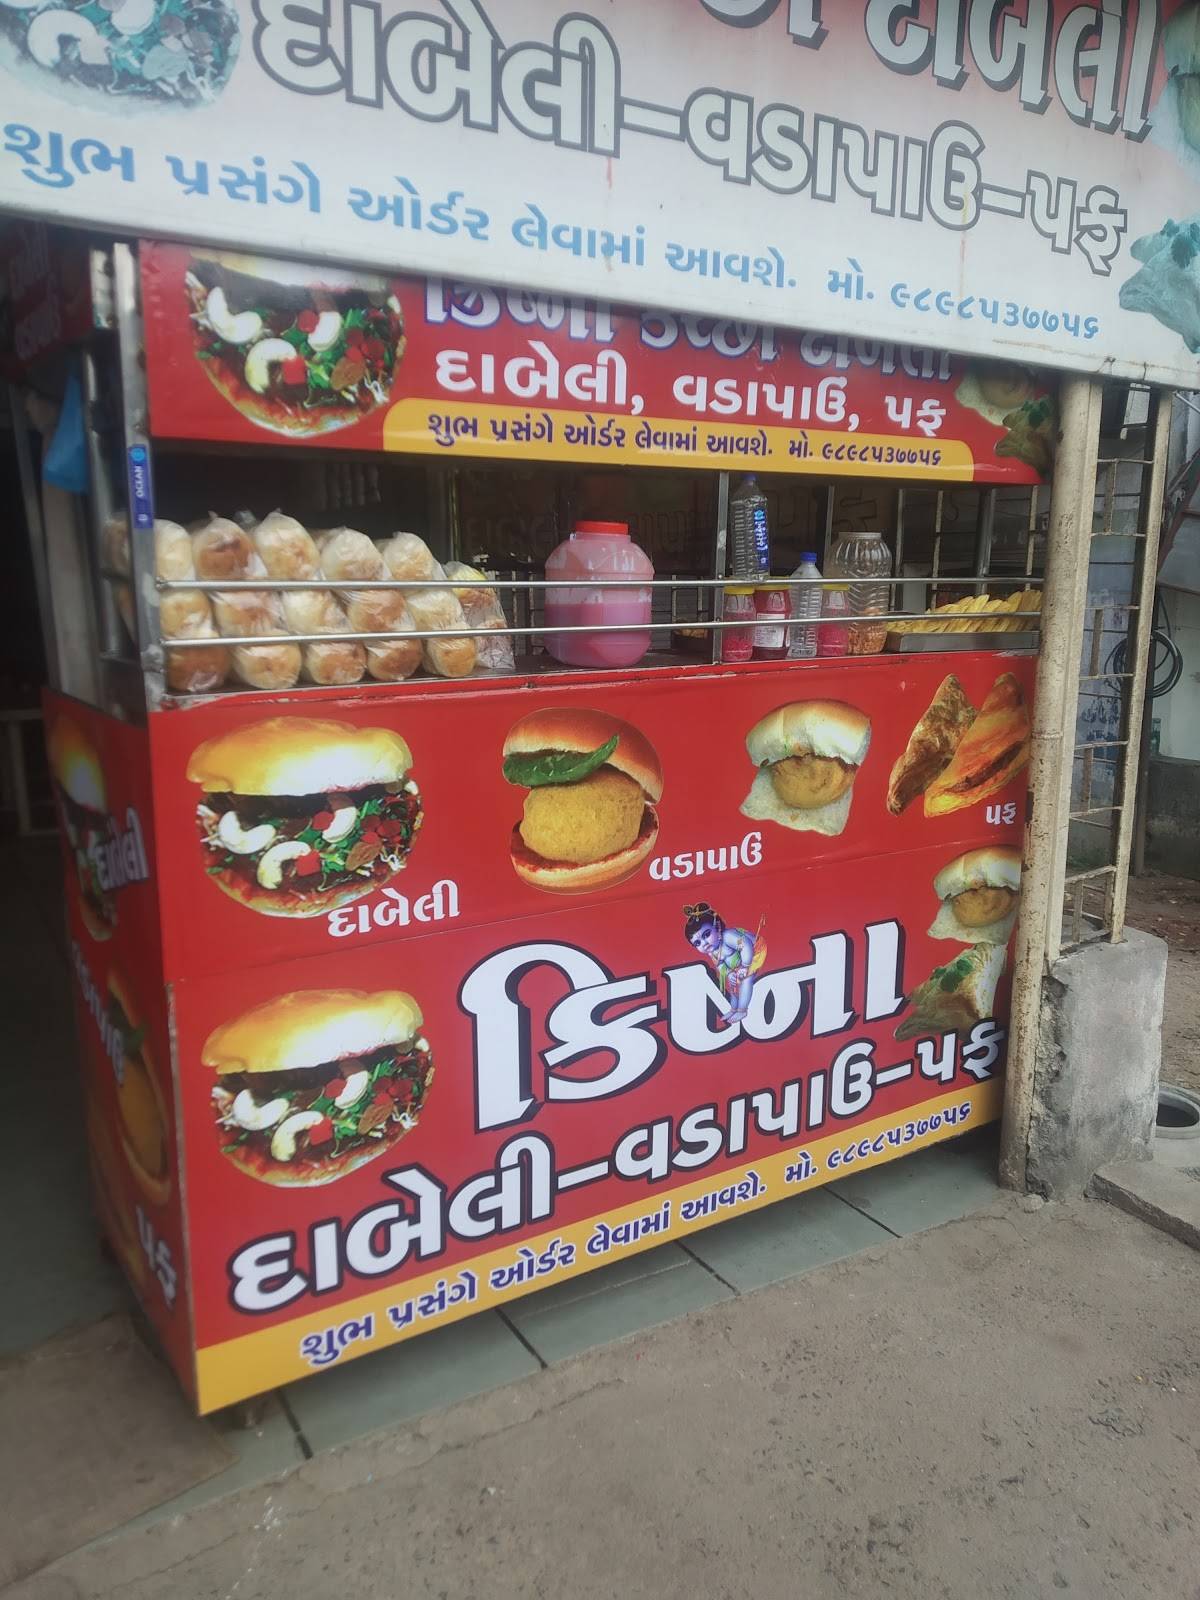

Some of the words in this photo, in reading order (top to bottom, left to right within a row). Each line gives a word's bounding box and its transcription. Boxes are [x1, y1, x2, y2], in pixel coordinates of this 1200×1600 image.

[3, 122, 136, 189] શુભ
[164, 154, 321, 214] પ્રસંગે
[347, 175, 490, 242] ઓર્ડર
[511, 200, 646, 267] લેવામાં
[664, 240, 798, 289] આવશે.
[827, 256, 875, 301] મો.
[890, 282, 1100, 340] ૯૮૯૮૫૩૭૭૫૬
[435, 338, 645, 416] દાબેલી,
[671, 373, 861, 433] વડાપાઉ,
[884, 392, 948, 438] પફ
[427, 412, 479, 448] શુભ
[489, 412, 554, 443] પ્રસંગે
[563, 413, 627, 449] ઓર્ડર
[635, 420, 698, 452] લેવામાં
[706, 428, 774, 457] આવશે.
[789, 430, 814, 459] મો.
[821, 442, 943, 467] ૯૮૯૮૫૩૭૭૫૬
[985, 800, 1017, 827] પફ
[648, 831, 764, 883] વડાપાઉ
[327, 878, 462, 938] દાબેલી
[301, 1313, 375, 1368] શુભ
[387, 1270, 479, 1332] પ્રસંગે
[488, 1238, 577, 1290] ઓર્ડર
[587, 1199, 672, 1256] લેવામાં
[681, 1172, 767, 1221] આવશે.
[785, 1150, 818, 1184] મો.
[827, 1101, 972, 1169] ૯૮૯૮૫૩૭૭૫૬
